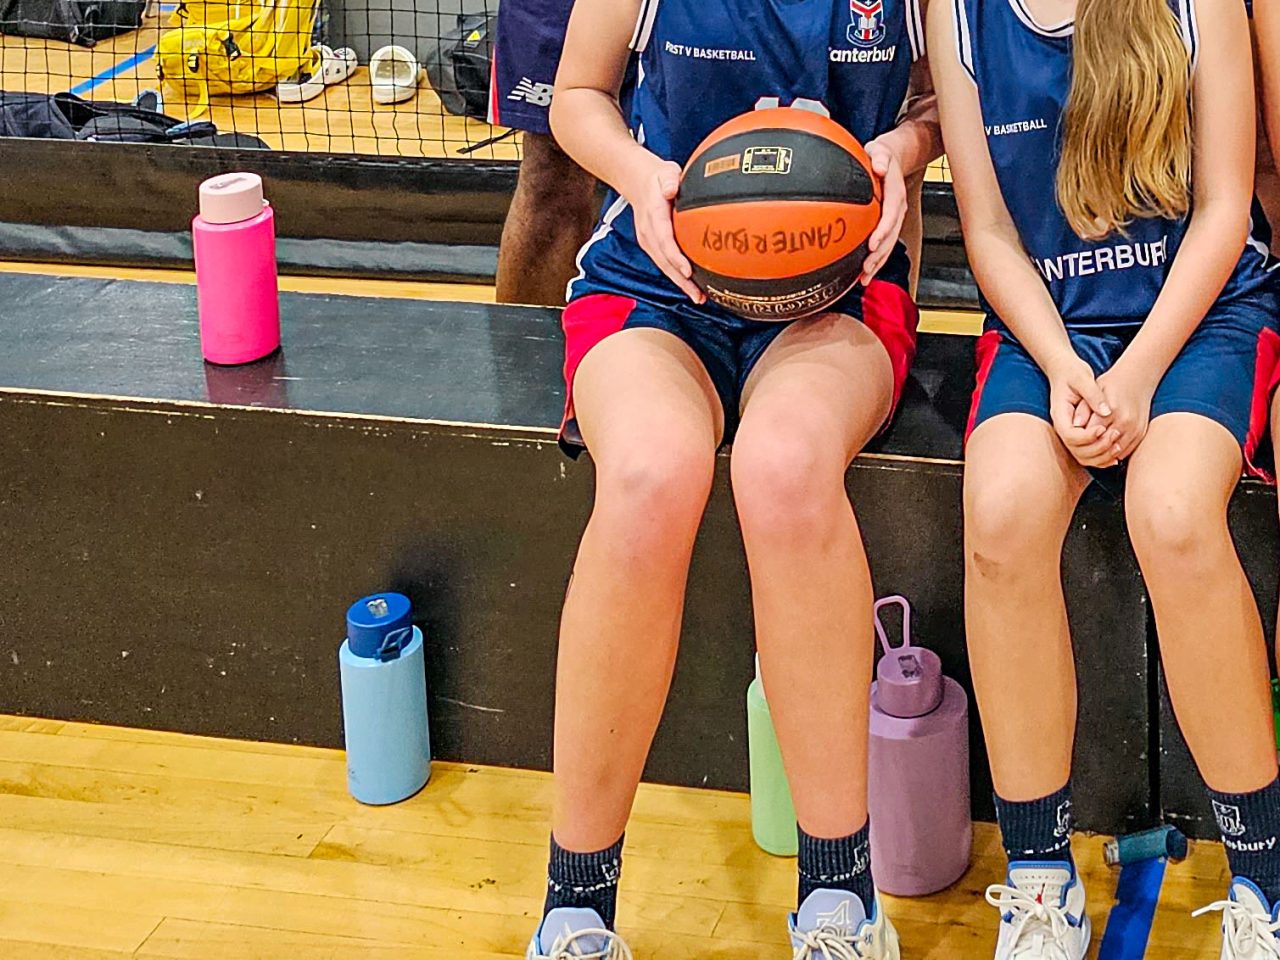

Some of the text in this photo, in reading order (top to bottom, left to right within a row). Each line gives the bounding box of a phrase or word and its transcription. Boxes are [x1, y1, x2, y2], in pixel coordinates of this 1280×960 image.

[685, 45, 692, 56] V
[693, 46, 756, 60] BASKETBALL
[993, 118, 1047, 136] BASKETBALL
